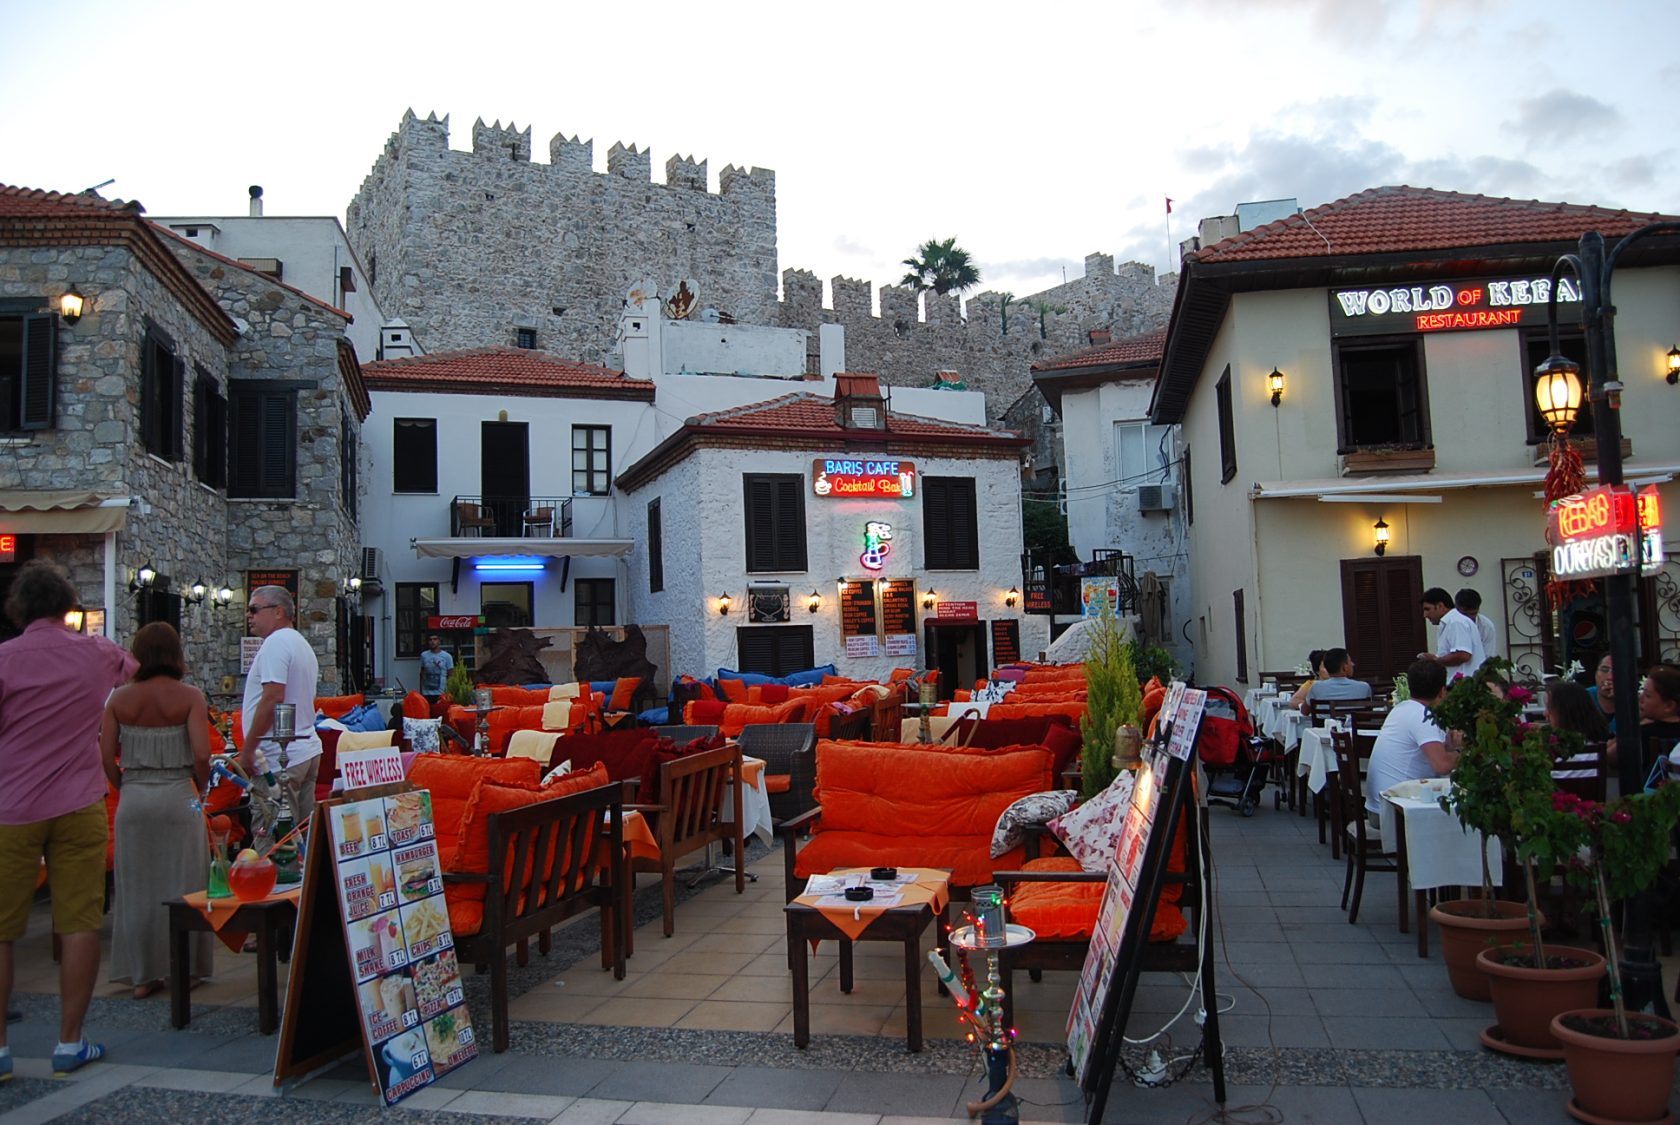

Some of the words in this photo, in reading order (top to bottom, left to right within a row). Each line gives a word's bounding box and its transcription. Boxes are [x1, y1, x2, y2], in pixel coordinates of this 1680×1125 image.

[1337, 285, 1453, 316] WORLD
[1457, 289, 1482, 306] OF
[1488, 278, 1583, 306] KEBA
[1416, 310, 1521, 330] RESTAURANT
[825, 460, 863, 476] BARIŞ
[866, 461, 899, 475] CAFE
[835, 477, 876, 492] Cocktail
[878, 479, 902, 492] Bar
[345, 761, 367, 788] FREE
[366, 757, 402, 783] WIRELESS
[392, 829, 413, 843] TOAST
[425, 826, 433, 836] TL
[378, 836, 386, 847] TL
[395, 844, 434, 863] HAMBURGER
[345, 874, 367, 888] FRESH
[433, 880, 442, 890] TL
[347, 886, 375, 902] ORANGE
[386, 893, 395, 904] TL
[443, 933, 451, 943] TL
[356, 947, 376, 961] MILK
[411, 941, 432, 956] CHIPS
[396, 951, 406, 962] TL
[360, 960, 384, 976] SHAKE
[454, 990, 463, 1001] TL
[422, 1001, 440, 1014] PIZZA
[370, 1012, 382, 1024] ICE
[409, 1012, 418, 1023] TL
[373, 1021, 398, 1039] COFFEE
[464, 1029, 472, 1040] TL
[418, 1052, 428, 1064] TL
[386, 1069, 432, 1100] CAPPUCCINO
